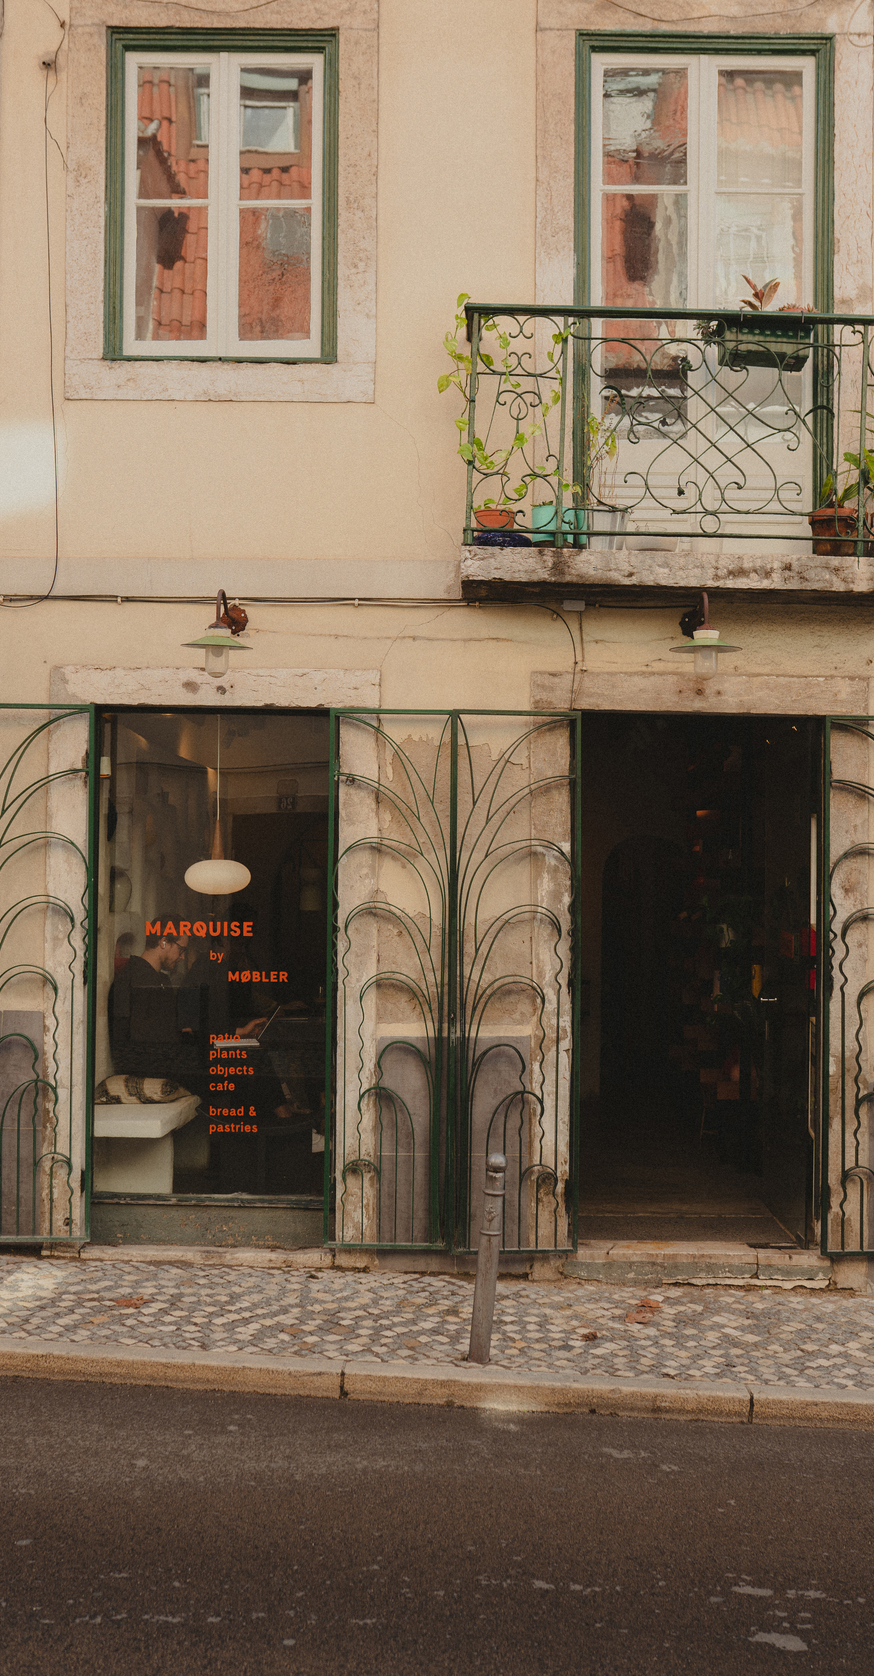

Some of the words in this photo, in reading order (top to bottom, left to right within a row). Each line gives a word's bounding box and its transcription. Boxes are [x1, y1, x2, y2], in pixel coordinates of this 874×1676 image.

[145, 920, 254, 938] MARQUISE
[209, 949, 225, 964] by
[227, 969, 289, 983] MØBLER
[209, 1032, 241, 1045] patio
[209, 1047, 248, 1061] plants
[209, 1064, 255, 1078] objects
[209, 1080, 236, 1091] cafe
[209, 1105, 244, 1117] bread
[248, 1105, 257, 1117] &
[209, 1121, 258, 1135] pastries
